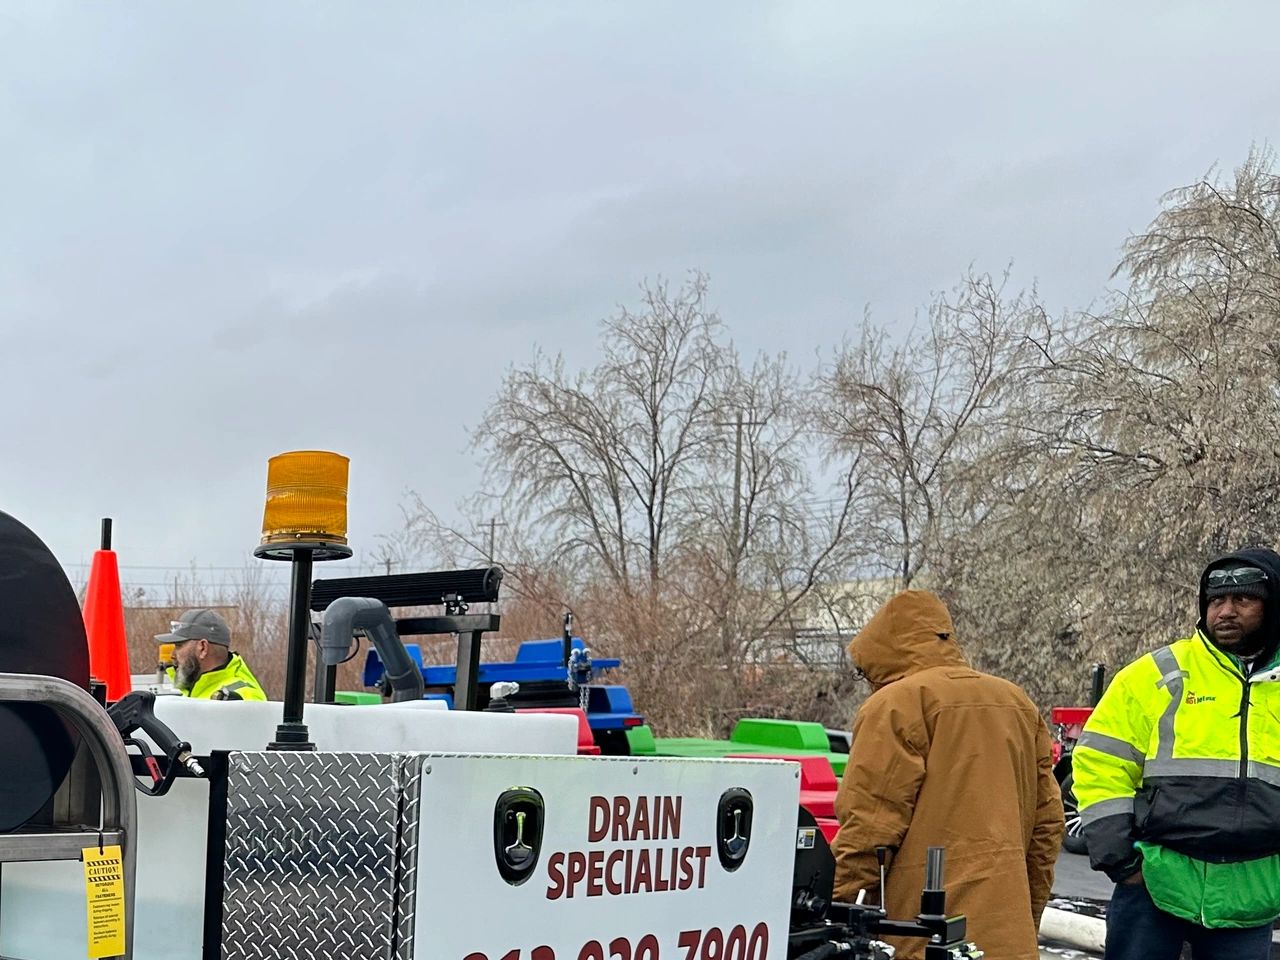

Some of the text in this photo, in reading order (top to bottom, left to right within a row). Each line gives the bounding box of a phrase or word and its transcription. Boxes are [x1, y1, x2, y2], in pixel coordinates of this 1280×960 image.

[587, 795, 682, 843] DRAIN
[88, 865, 119, 876] CAUTION!
[546, 846, 712, 900] SPECIALIST
